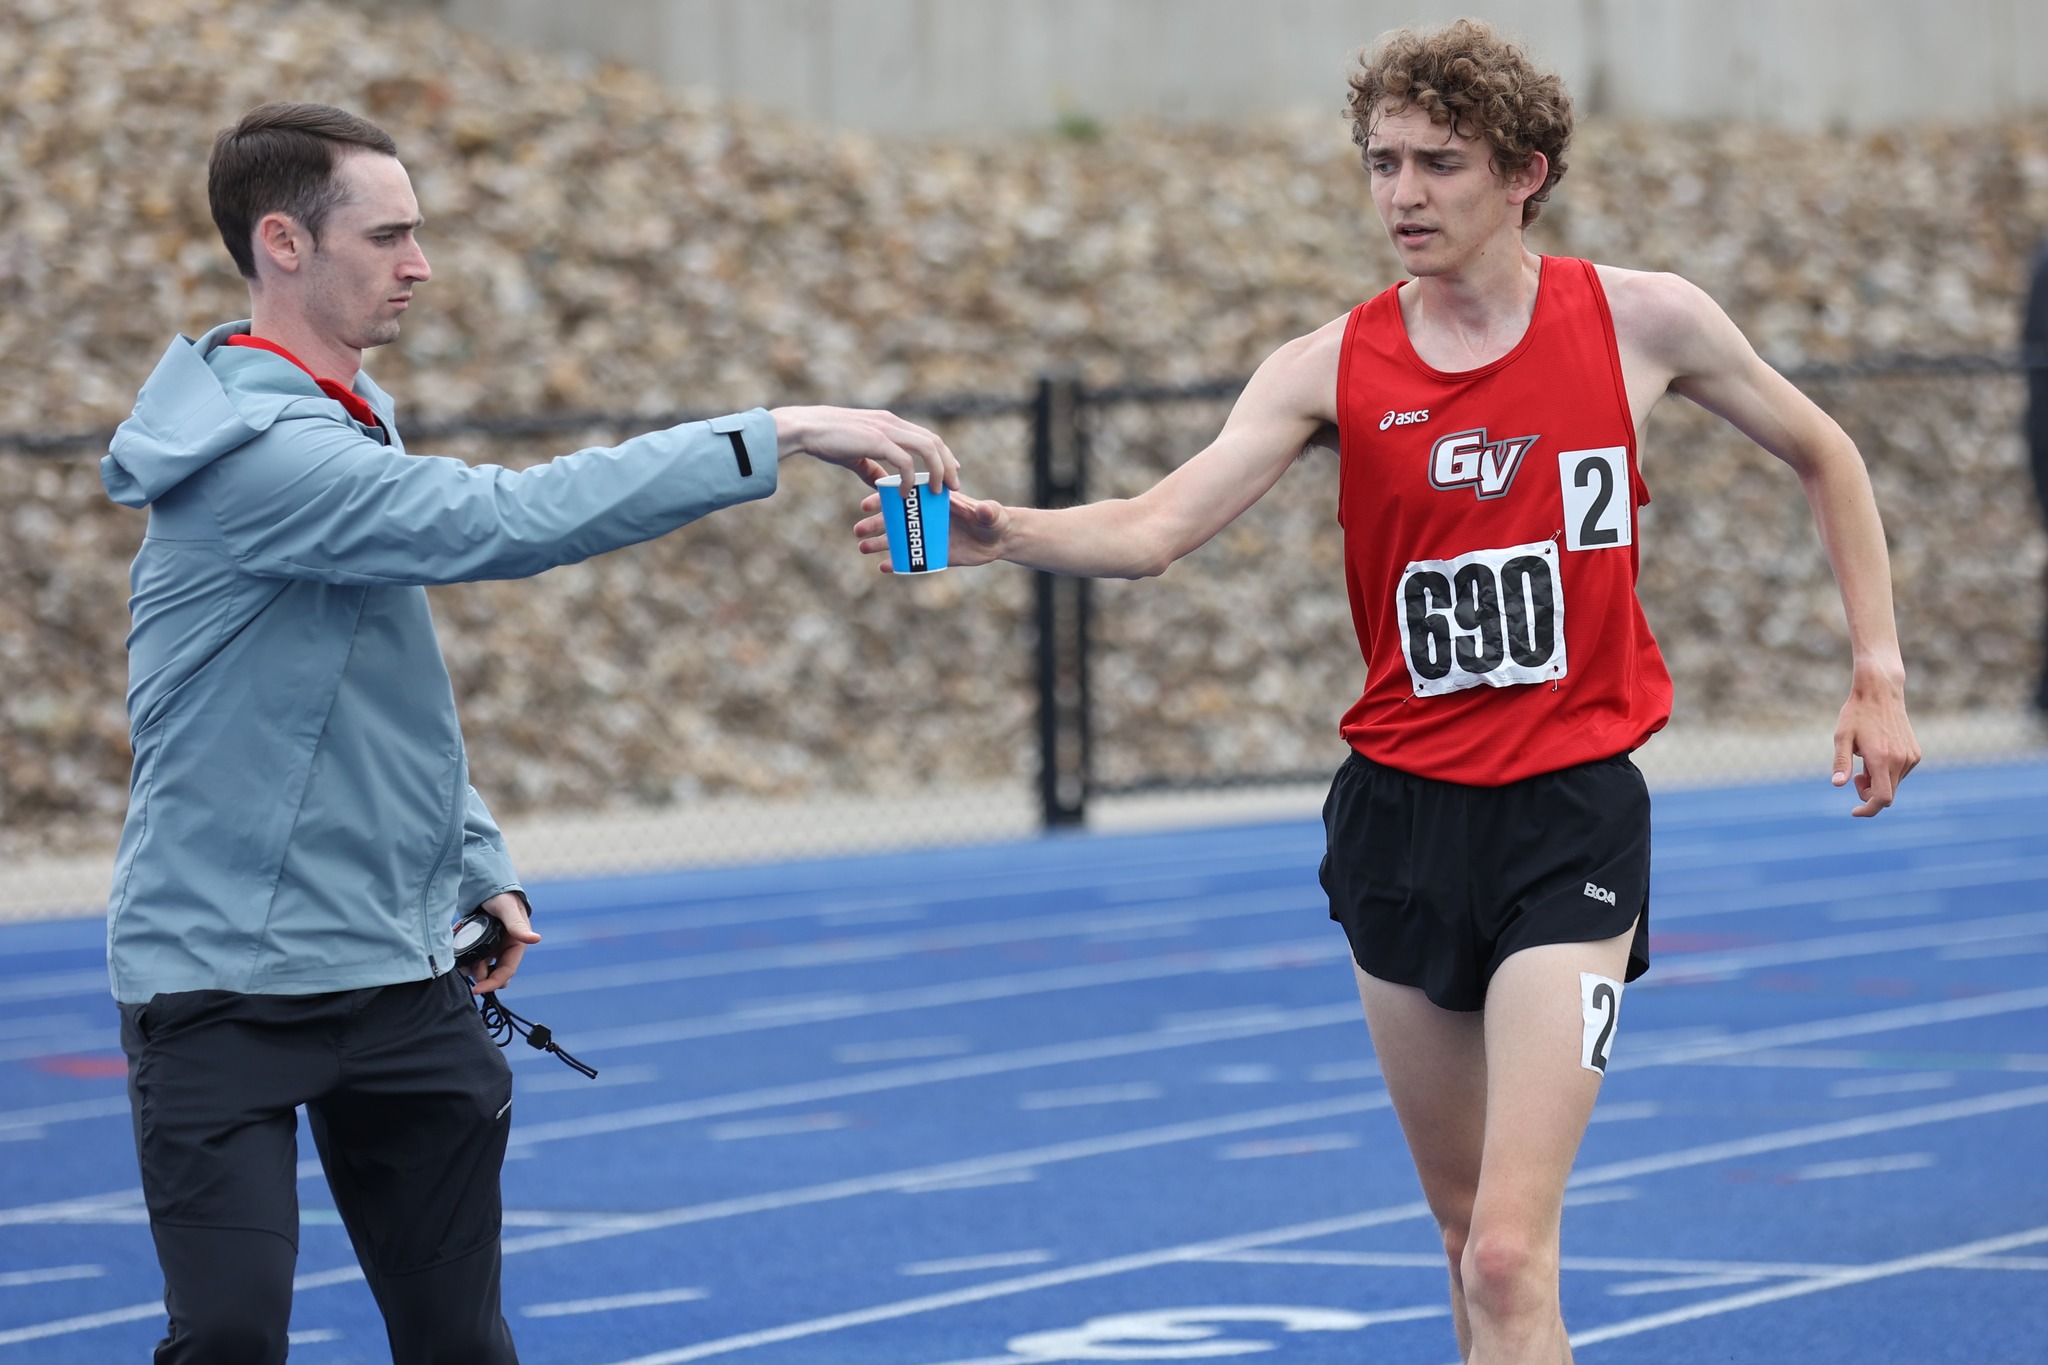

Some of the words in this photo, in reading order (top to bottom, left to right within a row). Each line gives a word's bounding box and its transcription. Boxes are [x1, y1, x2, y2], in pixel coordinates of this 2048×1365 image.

[1430, 430, 1534, 497] GV
[1574, 456, 1618, 546] 2
[1404, 555, 1556, 680] 690
[1591, 983, 1615, 1071] 2
